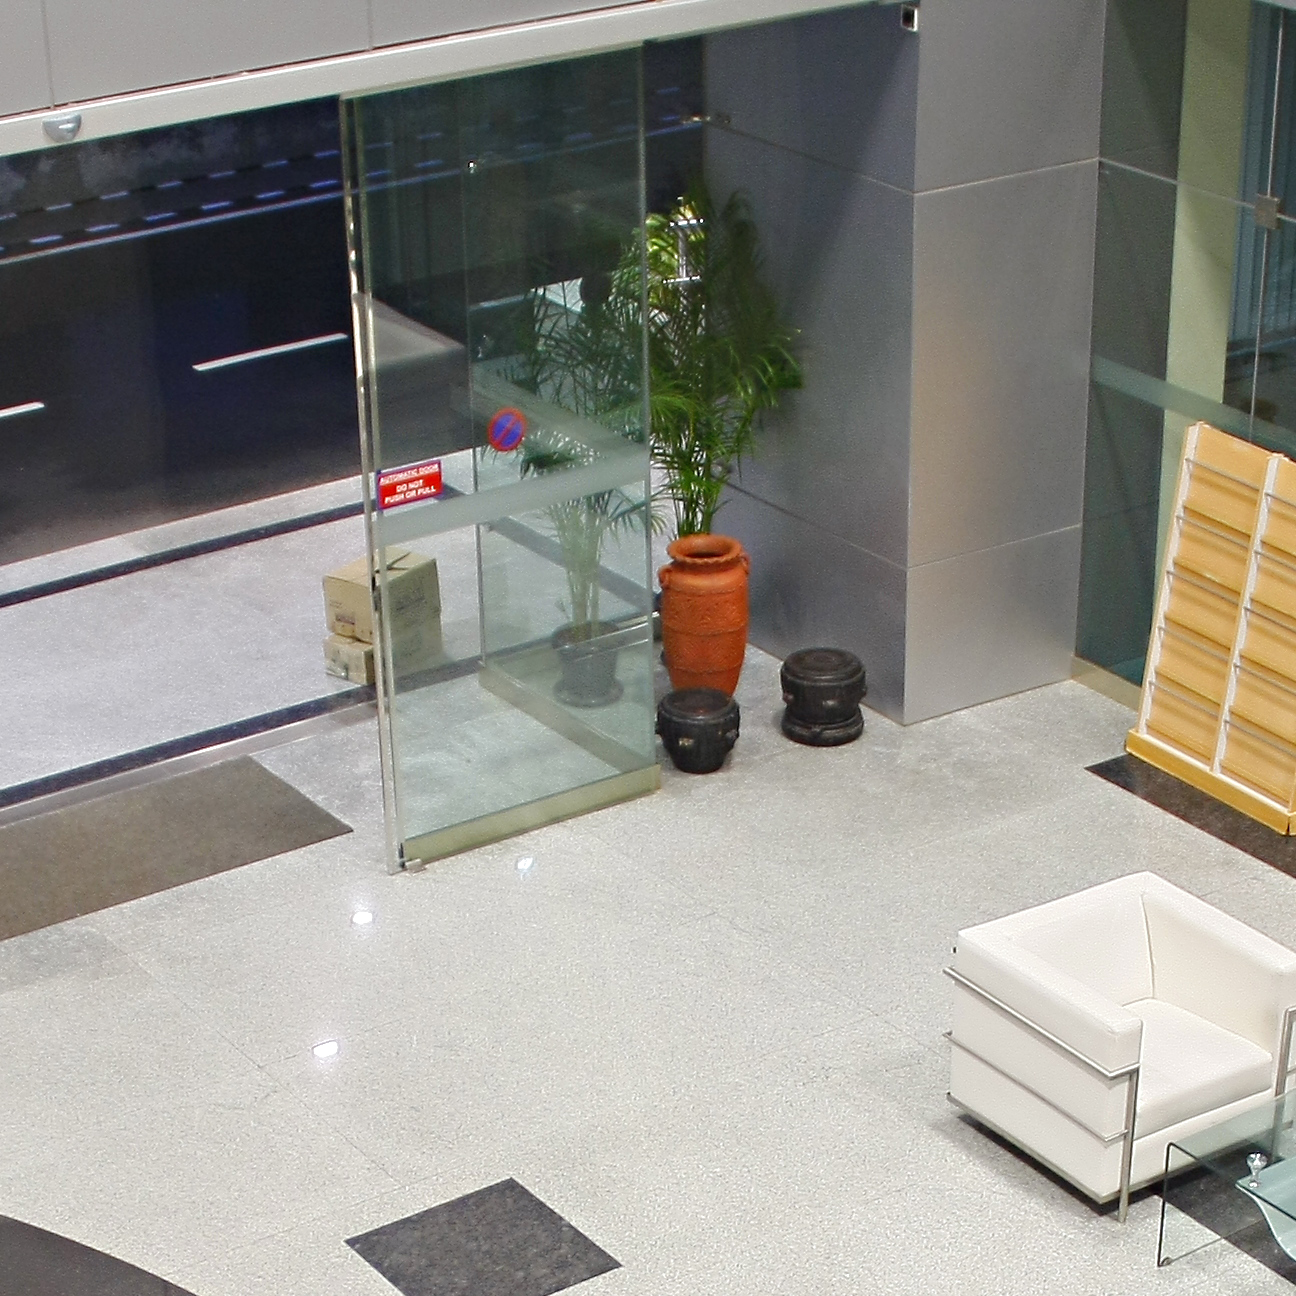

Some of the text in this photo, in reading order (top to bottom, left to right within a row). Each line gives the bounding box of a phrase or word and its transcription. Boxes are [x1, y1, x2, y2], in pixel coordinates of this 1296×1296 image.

[380, 469, 419, 485] AUTOMATIC
[396, 479, 424, 493] DO NOT
[384, 485, 437, 504] PUSH OR PULL
